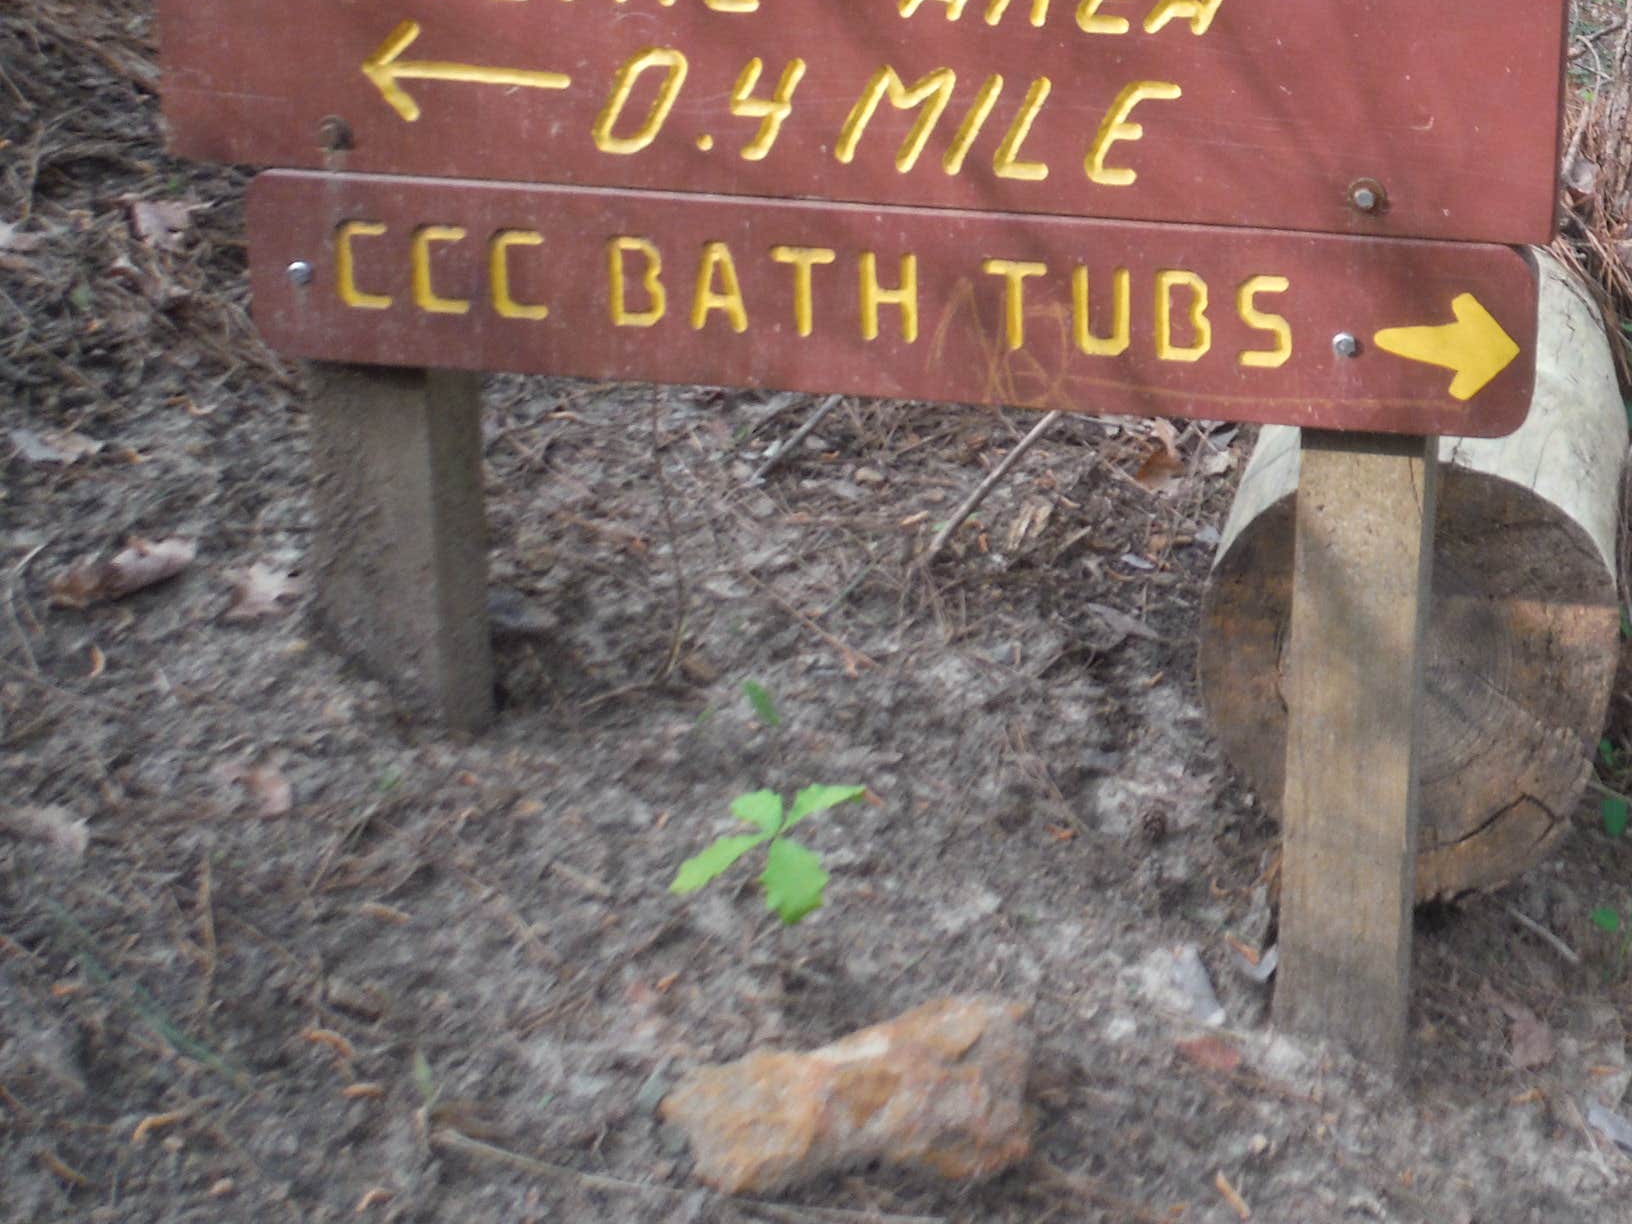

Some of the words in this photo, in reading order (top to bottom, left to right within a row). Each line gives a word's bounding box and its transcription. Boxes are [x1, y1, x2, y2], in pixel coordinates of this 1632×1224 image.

[592, 47, 806, 161] 0.4
[834, 64, 1182, 186] MILE
[334, 221, 549, 320] CCC
[607, 236, 918, 344] BATH
[983, 258, 1293, 368] TUBS
